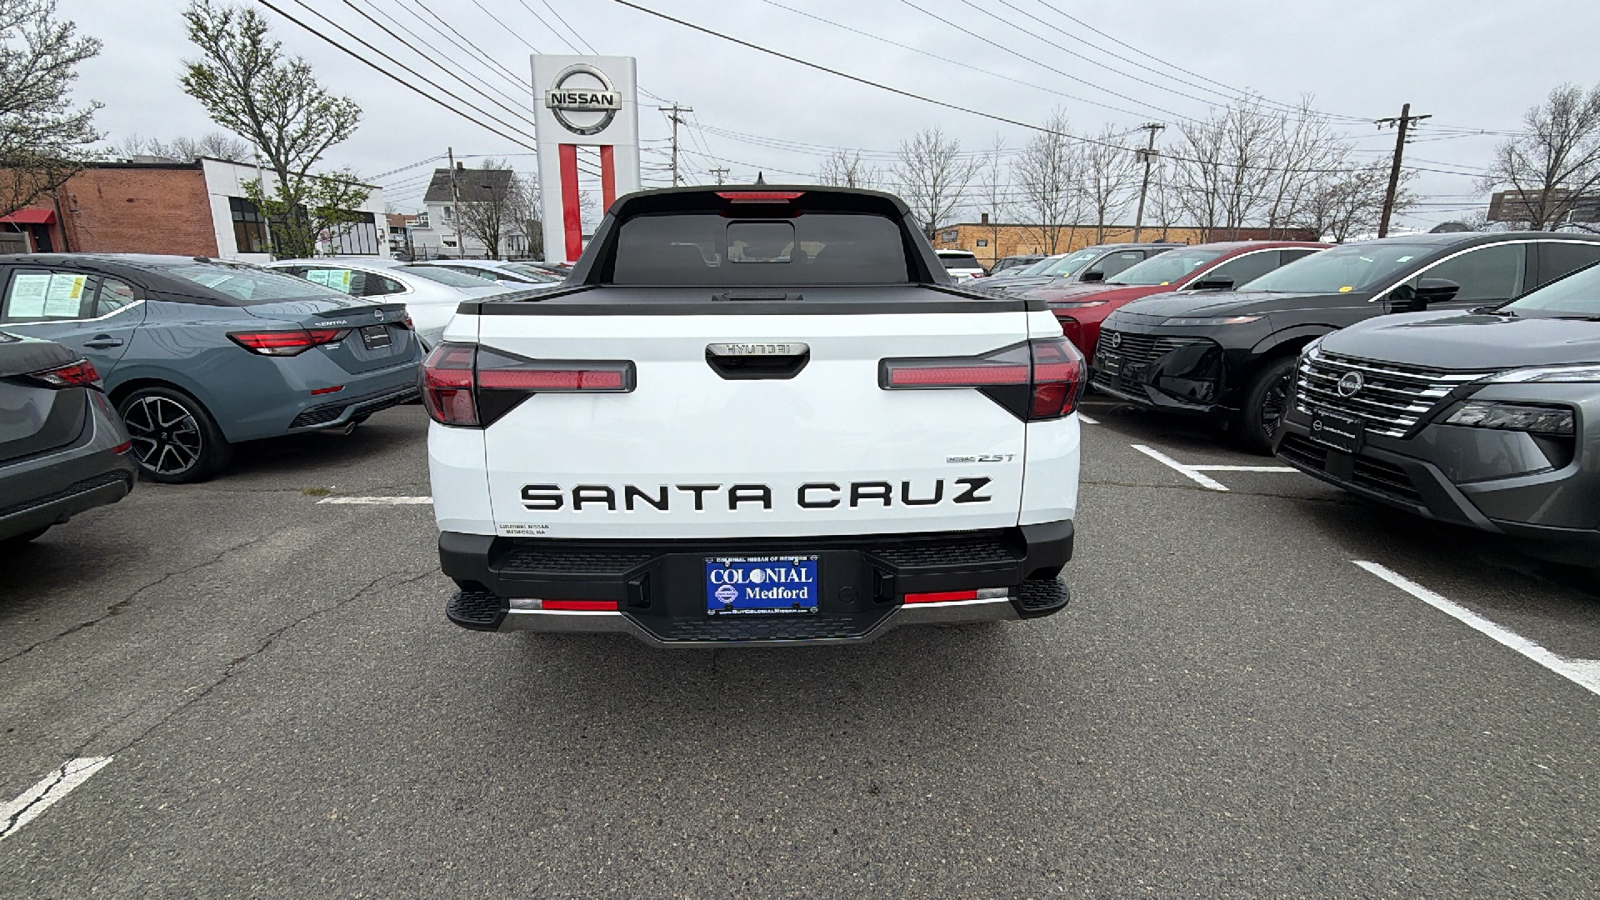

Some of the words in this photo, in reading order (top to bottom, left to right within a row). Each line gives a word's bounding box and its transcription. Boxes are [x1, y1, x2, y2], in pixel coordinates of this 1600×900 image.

[551, 93, 614, 106] NISSAN
[726, 344, 791, 355] HYUNDAI
[520, 484, 773, 512] SANTA
[797, 477, 992, 509] CRUZ
[710, 568, 813, 584] COLONIAL
[745, 586, 808, 599] Medford
